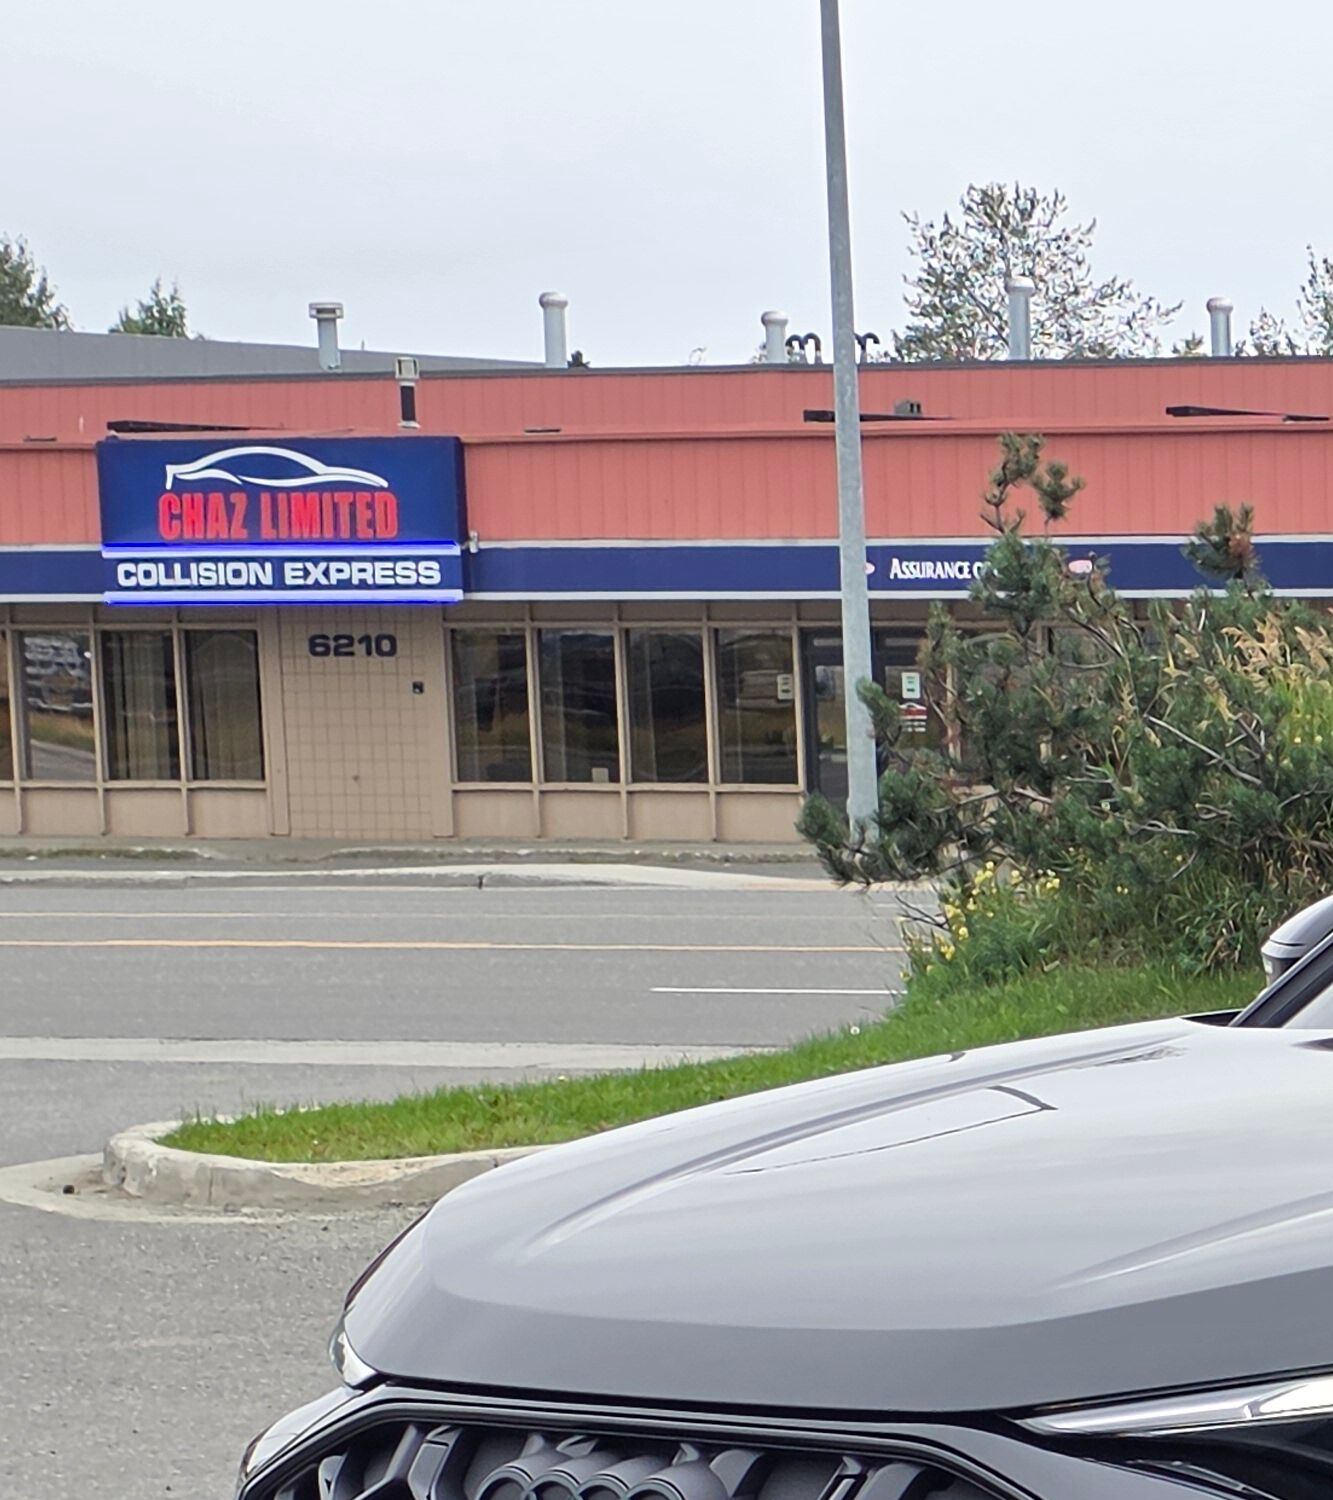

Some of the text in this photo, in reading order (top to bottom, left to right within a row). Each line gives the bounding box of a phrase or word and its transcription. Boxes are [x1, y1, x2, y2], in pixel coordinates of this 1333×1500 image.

[158, 490, 398, 540] CHAZ LIMITED
[117, 560, 441, 587] COLLISION EXPRESS
[889, 558, 972, 580] ASSURANCE
[308, 633, 398, 658] 6210
